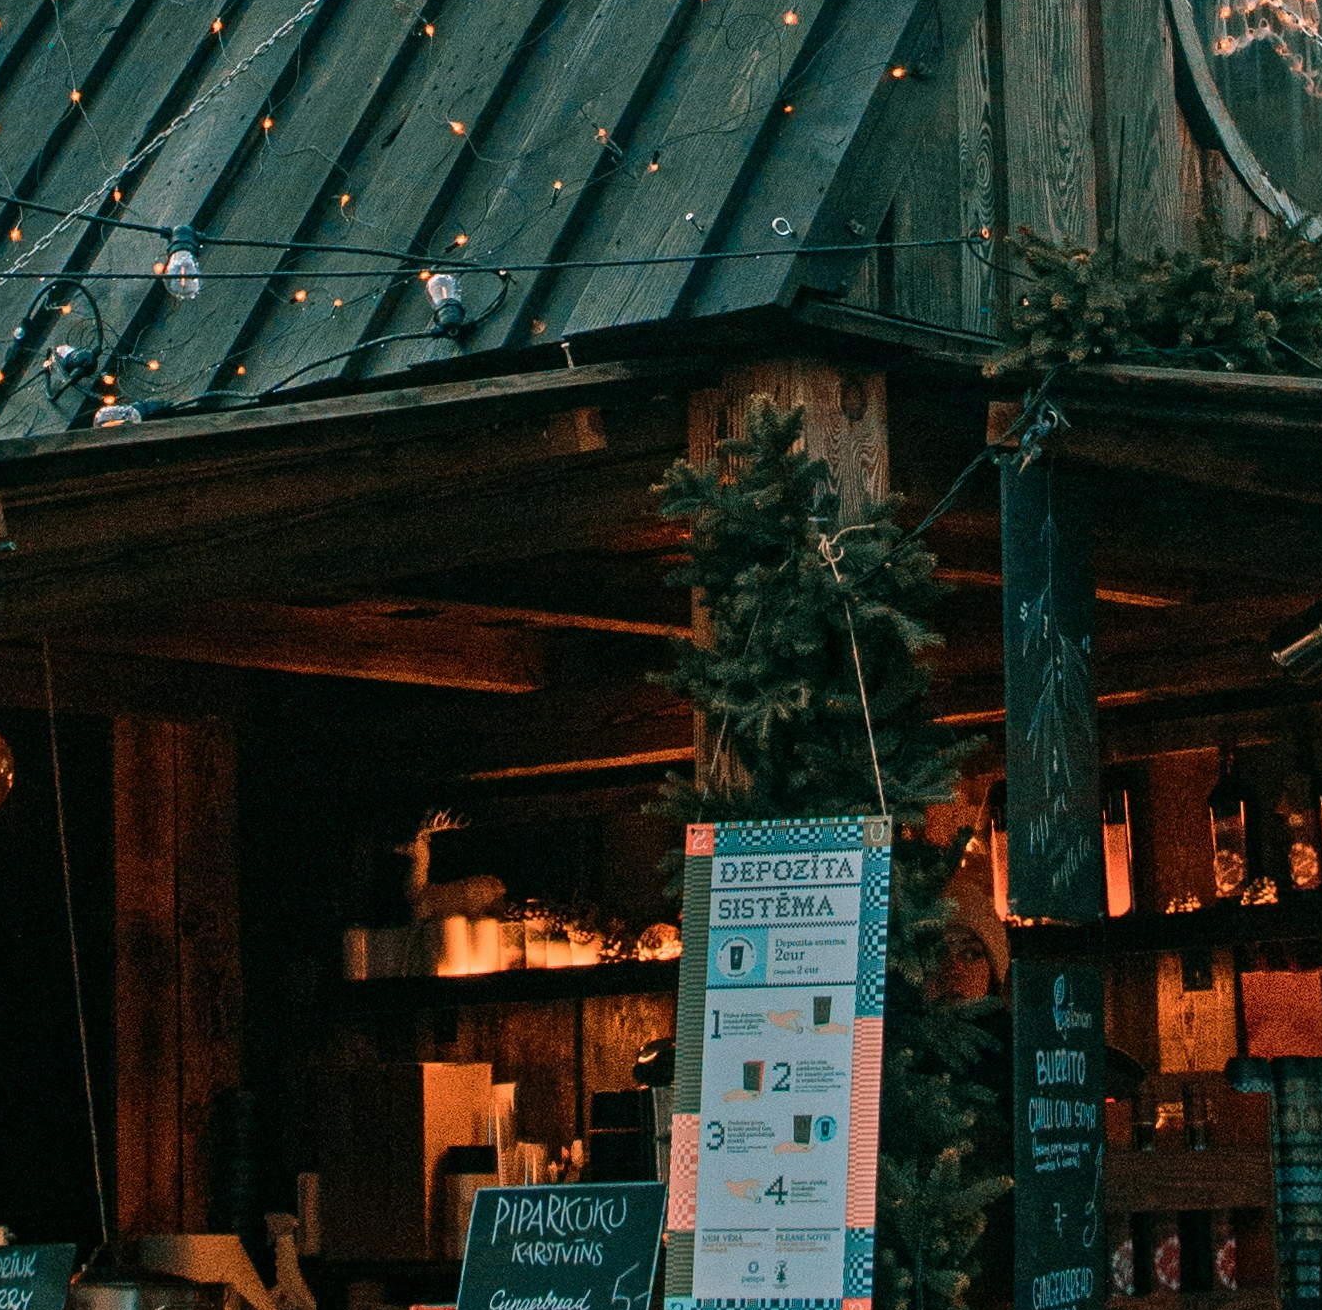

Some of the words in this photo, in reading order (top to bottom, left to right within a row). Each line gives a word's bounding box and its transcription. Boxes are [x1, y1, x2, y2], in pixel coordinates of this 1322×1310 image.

[718, 892, 834, 920] SISTĒMA
[711, 1010, 721, 1039] 1
[772, 1062, 791, 1091] 2
[1036, 1048, 1086, 1085] BURRITO
[706, 1121, 725, 1151] 3
[764, 1176, 788, 1205] 4
[512, 1238, 603, 1266] KARSTVĪNS
